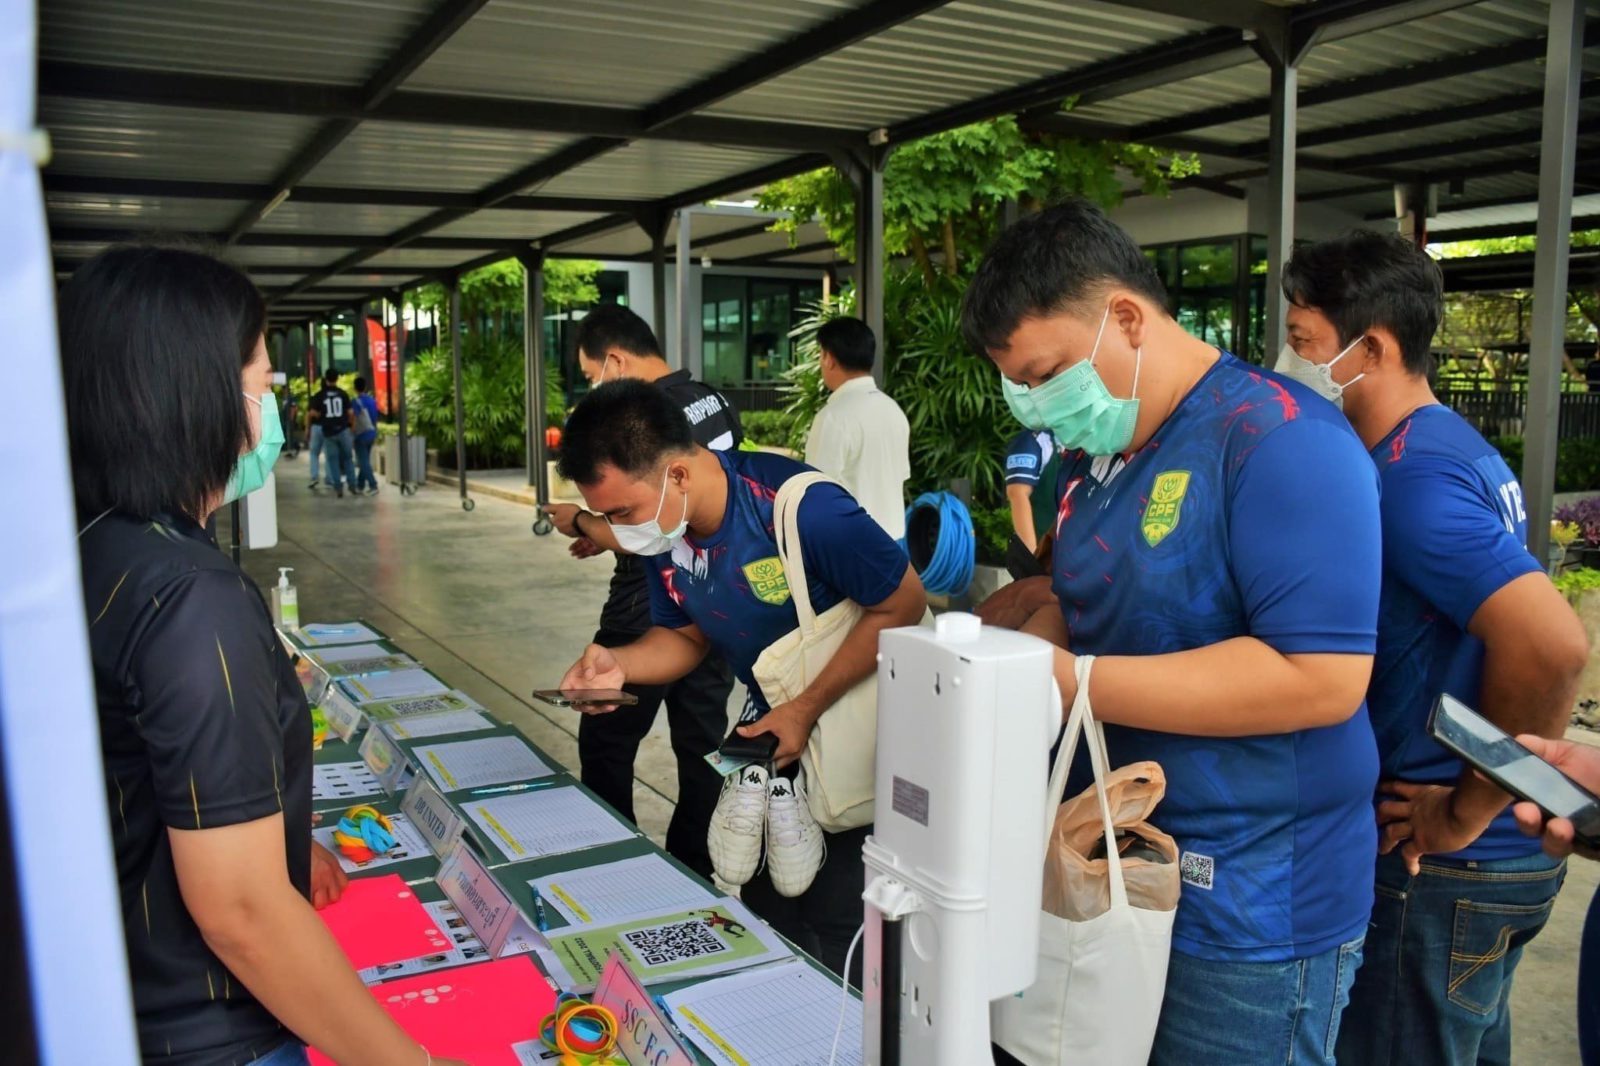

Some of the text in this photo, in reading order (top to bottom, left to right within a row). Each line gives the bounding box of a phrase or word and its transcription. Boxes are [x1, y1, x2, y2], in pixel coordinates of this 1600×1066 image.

[323, 397, 342, 418] 10
[1148, 503, 1176, 517] CPF
[756, 576, 785, 592] CPF
[422, 806, 446, 840] UNITED
[621, 999, 648, 1045] SSC
